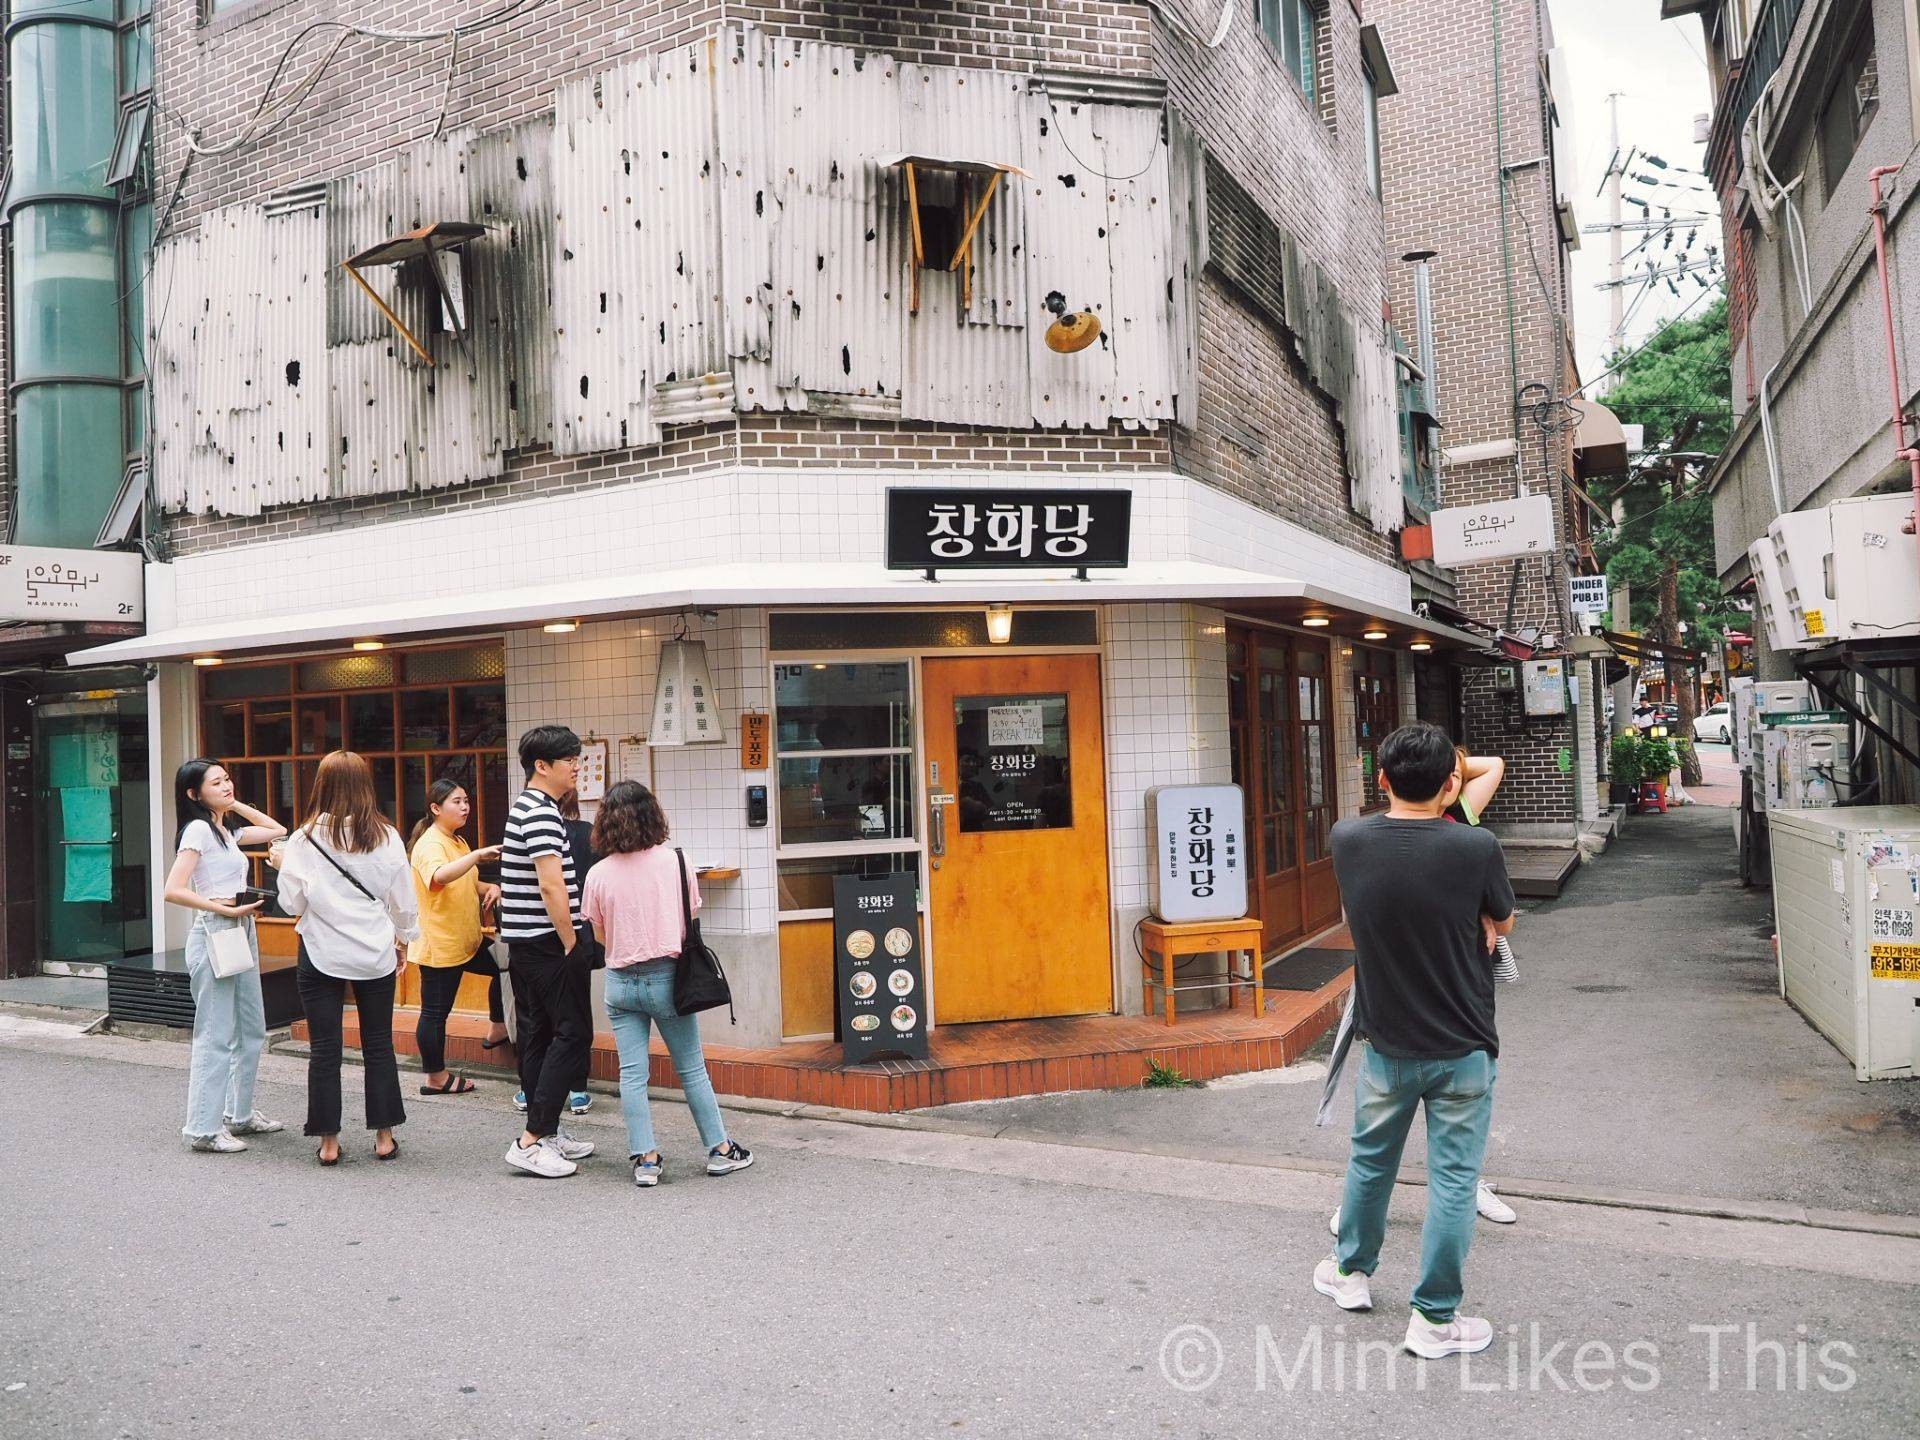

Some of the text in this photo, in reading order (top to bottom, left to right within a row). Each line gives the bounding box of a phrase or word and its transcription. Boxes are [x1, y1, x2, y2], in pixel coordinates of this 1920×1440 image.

[926, 502, 1095, 558] 창화당
[1528, 541, 1538, 549] 2F
[0, 555, 12, 565] 2F
[1571, 579, 1604, 590] UNDER
[118, 603, 134, 614] 2F
[749, 717, 762, 766] 만두포장
[990, 754, 1036, 771] 창화당
[1188, 807, 1216, 898] 창화당
[857, 894, 895, 909] 창화당
